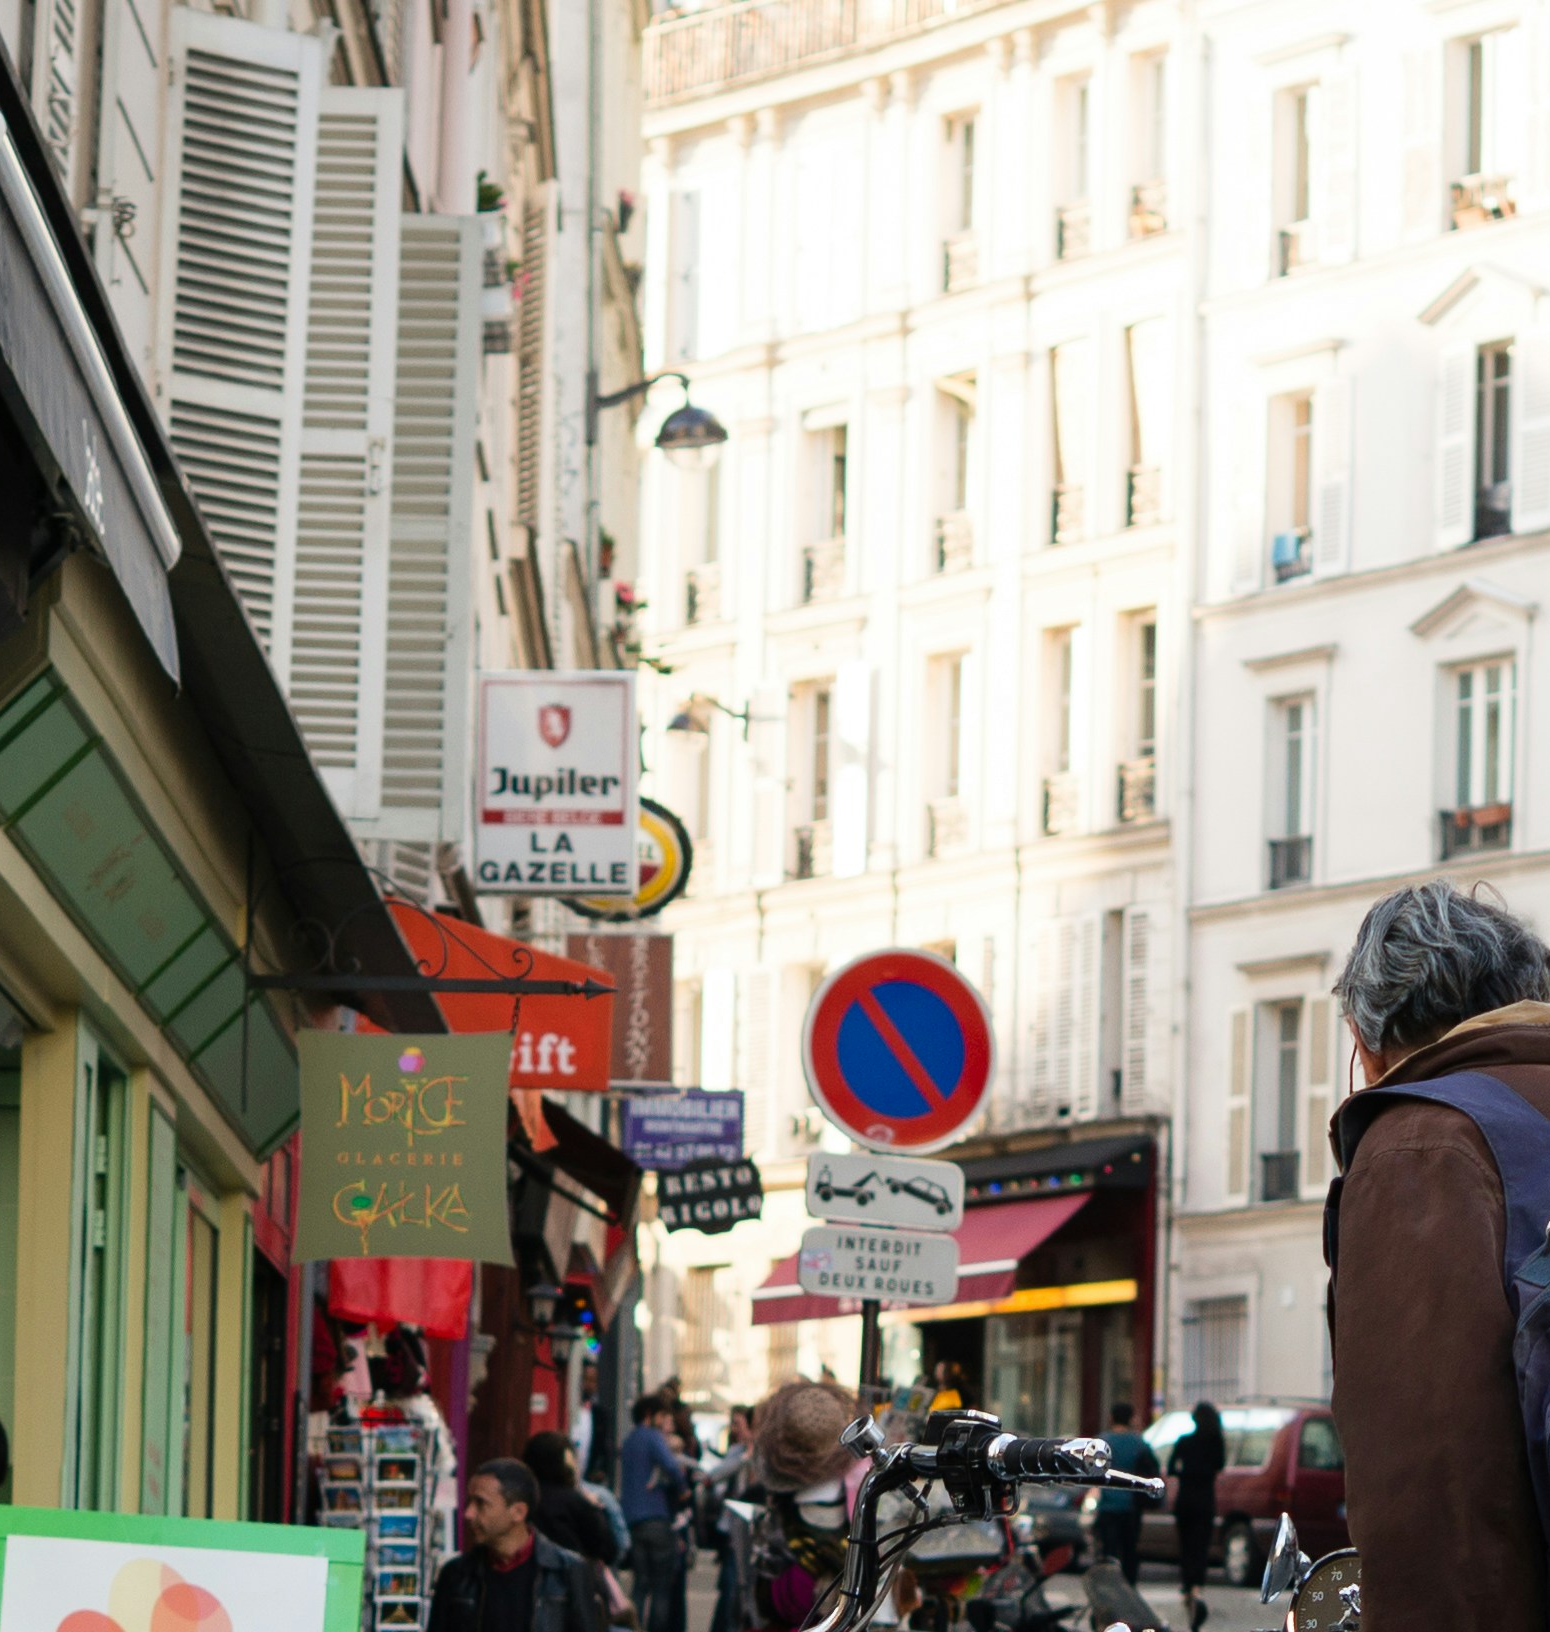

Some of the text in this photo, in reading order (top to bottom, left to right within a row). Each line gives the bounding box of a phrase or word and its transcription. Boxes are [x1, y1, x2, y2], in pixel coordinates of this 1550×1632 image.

[491, 767, 619, 802] Jupiler
[531, 832, 573, 854] LA
[480, 861, 628, 884] GAZELLE
[512, 1032, 577, 1075] ift
[337, 1152, 464, 1166] GLACERIE
[664, 1165, 751, 1197] RESTO
[660, 1194, 762, 1224] RIGOLO
[837, 1236, 922, 1257] INTERDIT
[856, 1256, 902, 1273] SAUF
[818, 1272, 934, 1296] DEUX ROUES
[1331, 1570, 1343, 1581] 70
[1312, 1591, 1324, 1602] 50
[1306, 1618, 1318, 1629] 30
